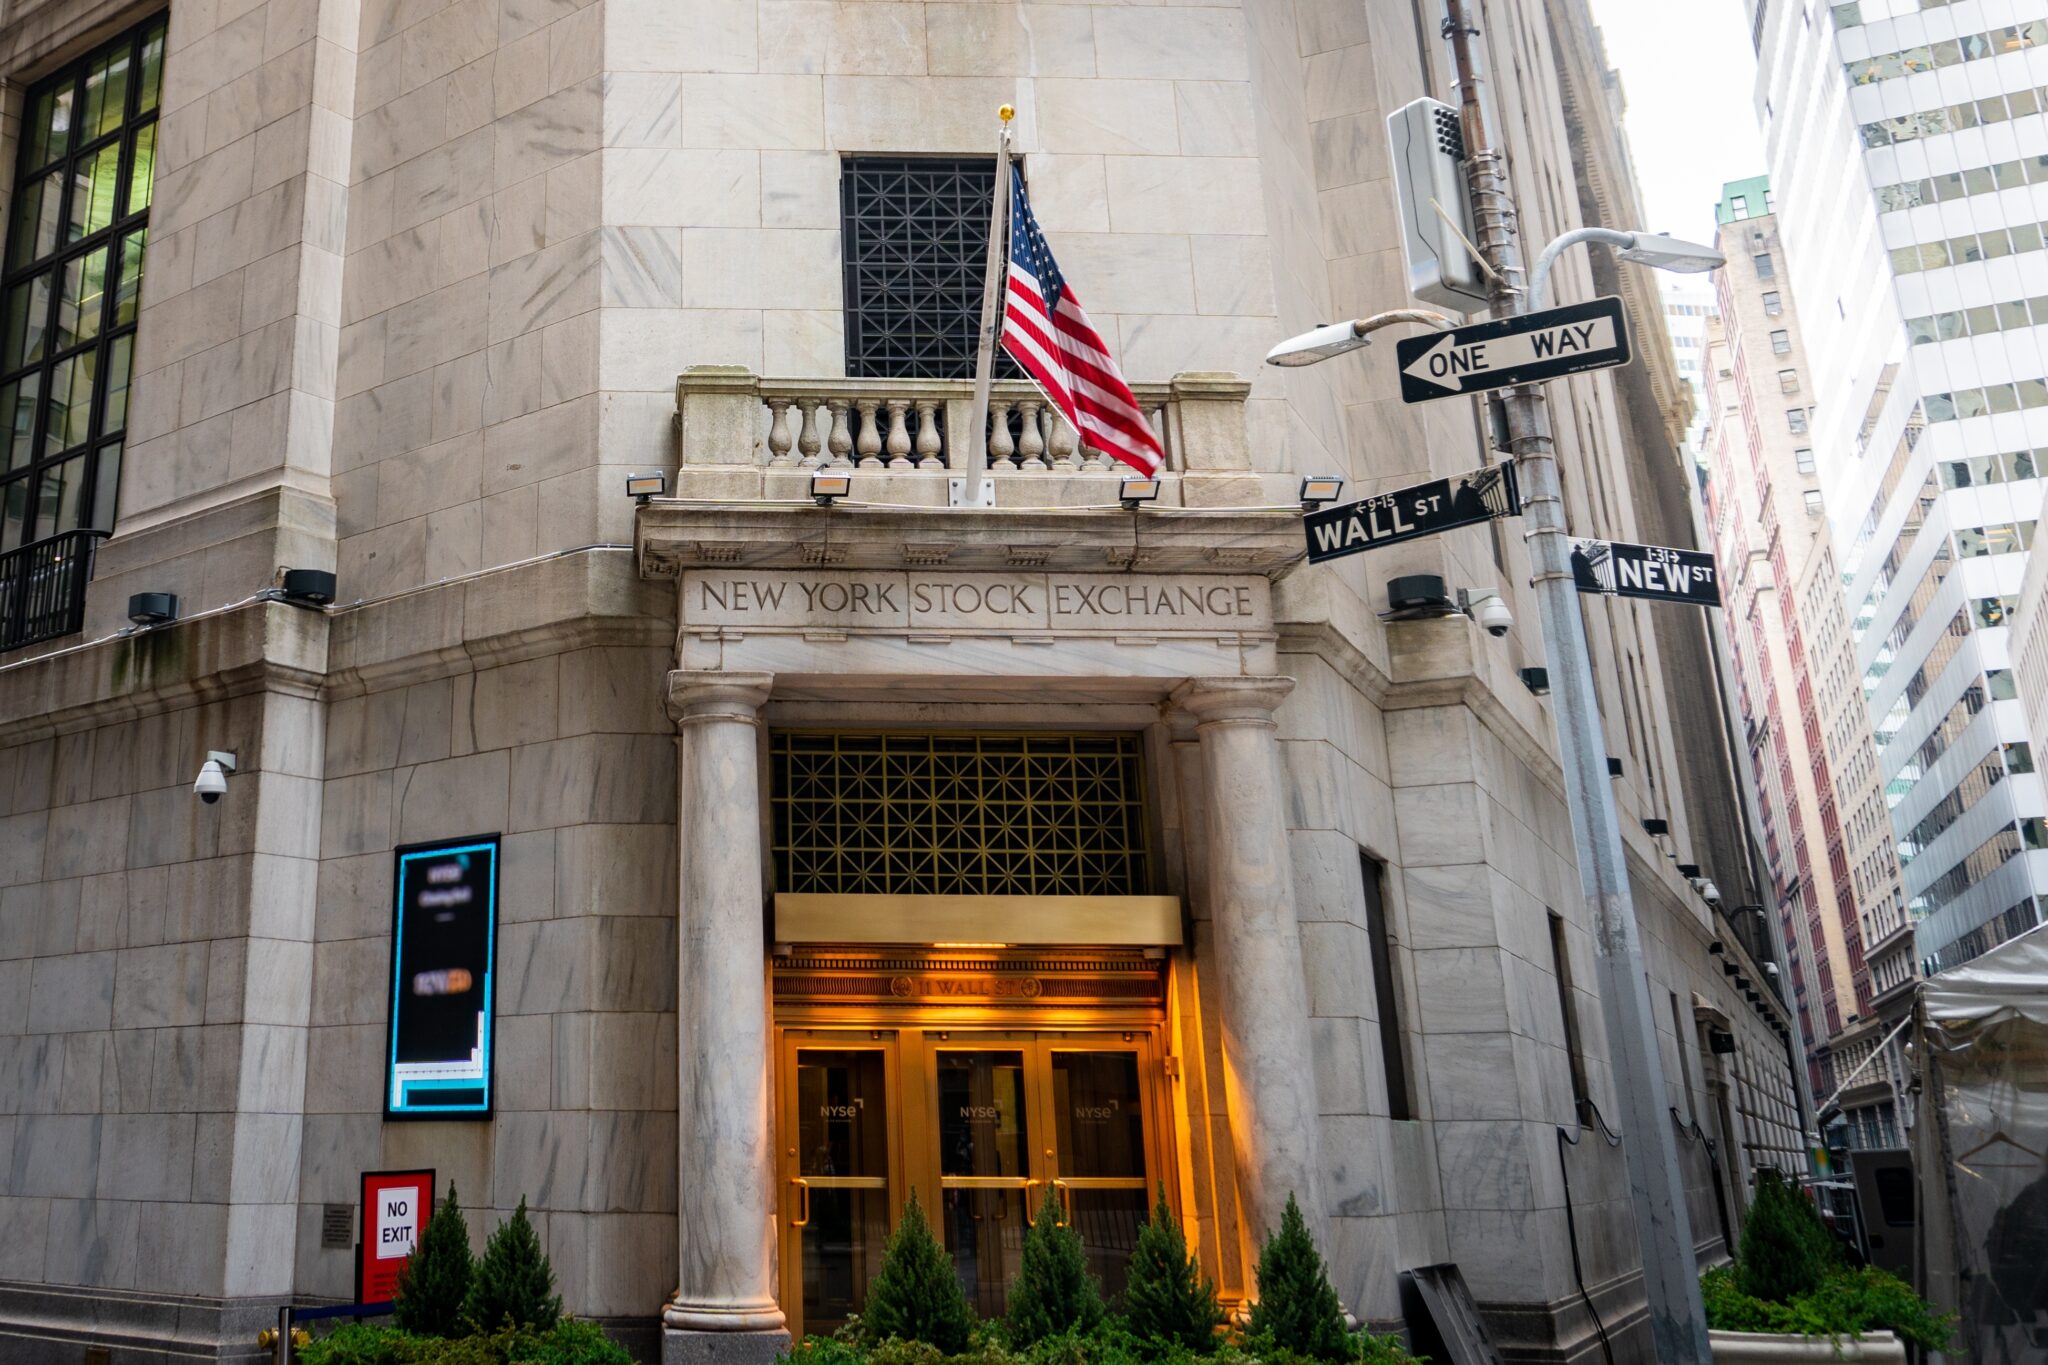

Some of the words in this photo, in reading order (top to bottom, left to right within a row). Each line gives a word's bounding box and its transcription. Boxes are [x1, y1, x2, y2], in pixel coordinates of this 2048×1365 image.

[1429, 345, 1489, 378] ONE
[1530, 323, 1595, 359] WAY
[1367, 494, 1396, 512] 9-15
[1314, 505, 1415, 552] WALL
[1414, 495, 1441, 516] ST
[1645, 548, 1670, 563] 1-31
[1617, 557, 1690, 594] NEW
[1691, 565, 1713, 583] ST
[700, 580, 787, 612] NEW
[798, 582, 900, 615] YORK
[914, 583, 1036, 614] STOCK
[1055, 584, 1253, 617] EXCHANGE
[936, 980, 990, 996] WALL
[994, 980, 1014, 995] ST
[387, 1201, 408, 1217] NO
[382, 1226, 412, 1243] EXIT
